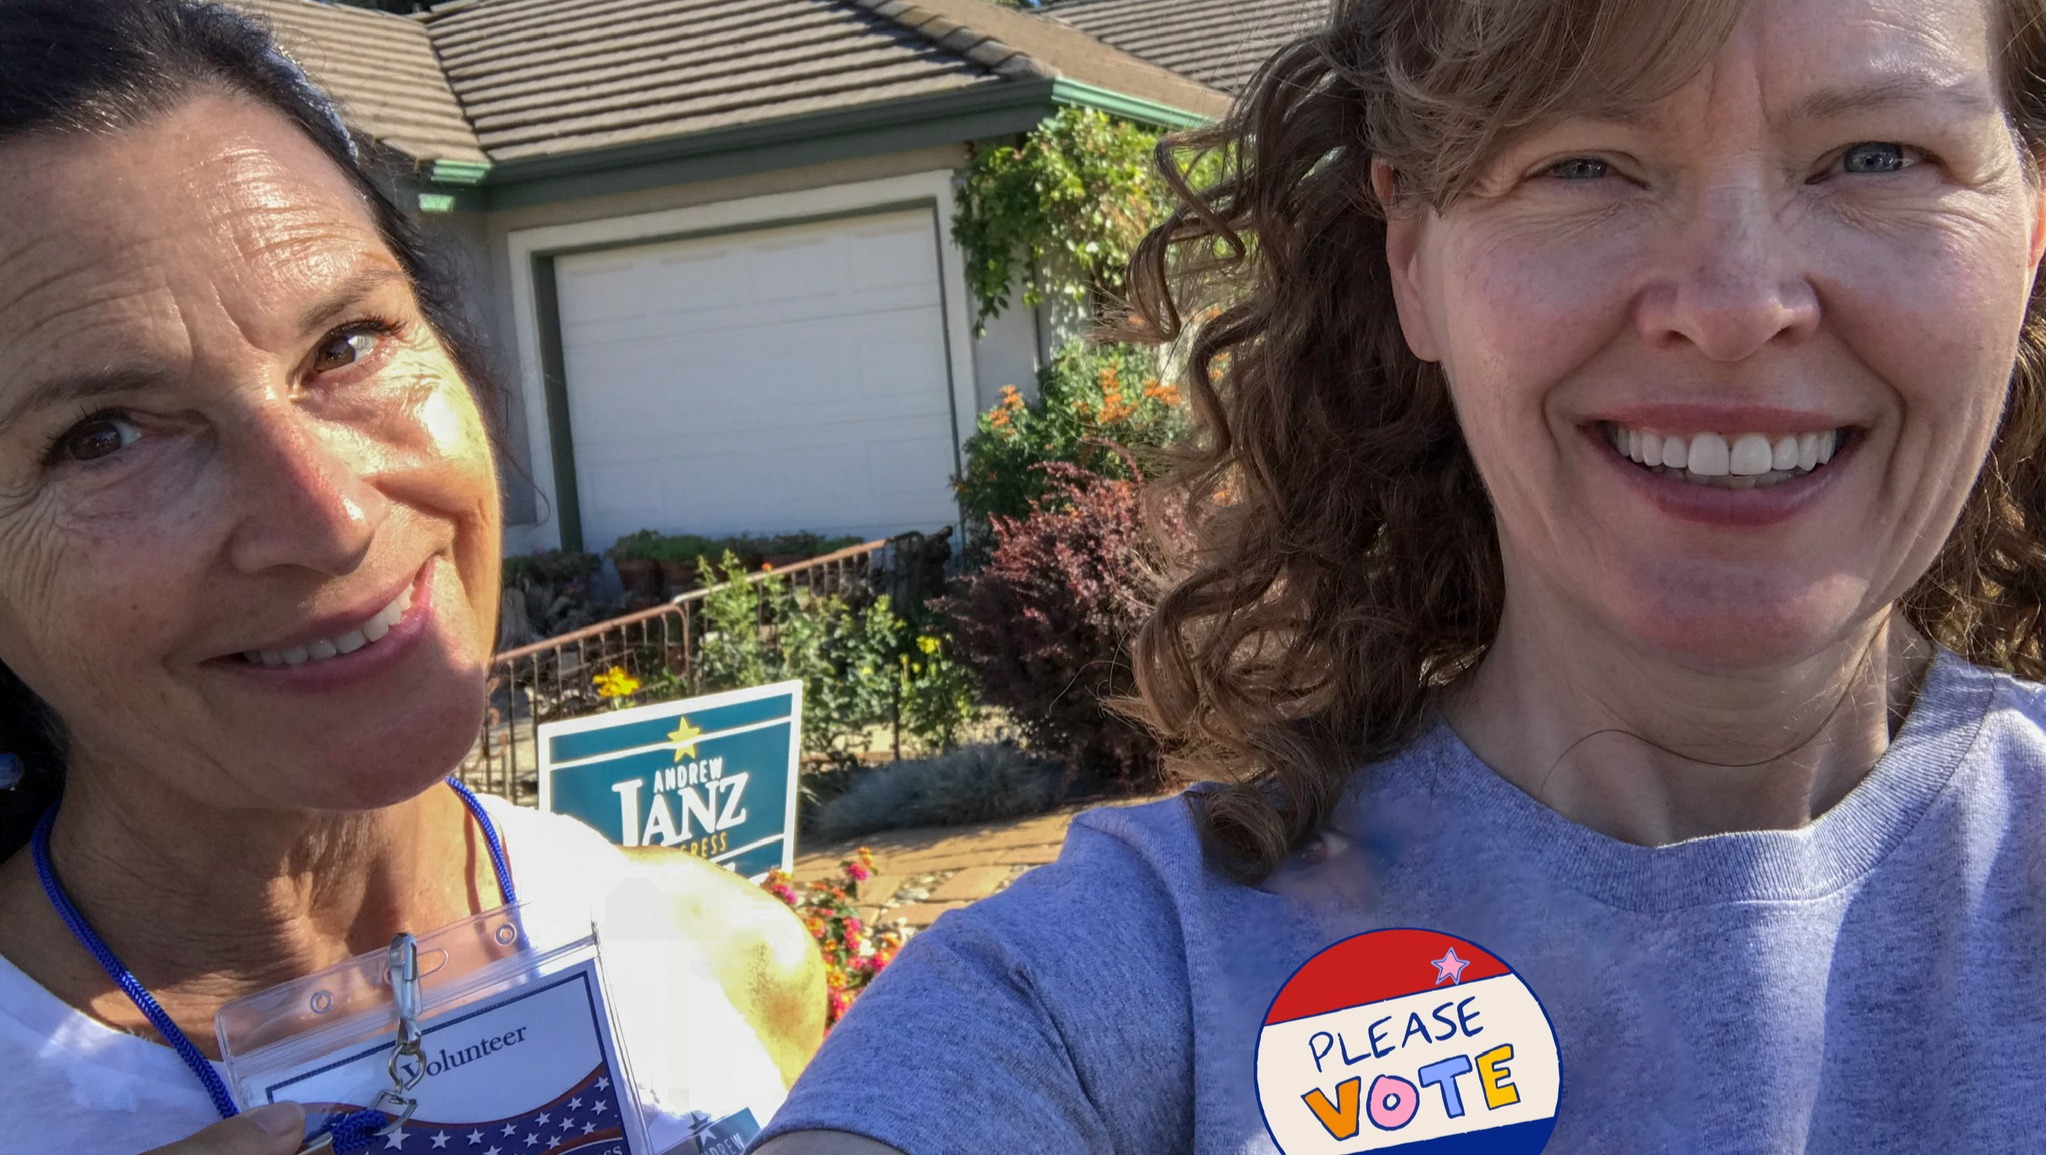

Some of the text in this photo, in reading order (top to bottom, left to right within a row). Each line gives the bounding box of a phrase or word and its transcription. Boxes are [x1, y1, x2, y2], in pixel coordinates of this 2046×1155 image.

[652, 756, 723, 793] ANDREW
[611, 772, 749, 847] JANZ
[400, 1026, 527, 1077] Volunteer
